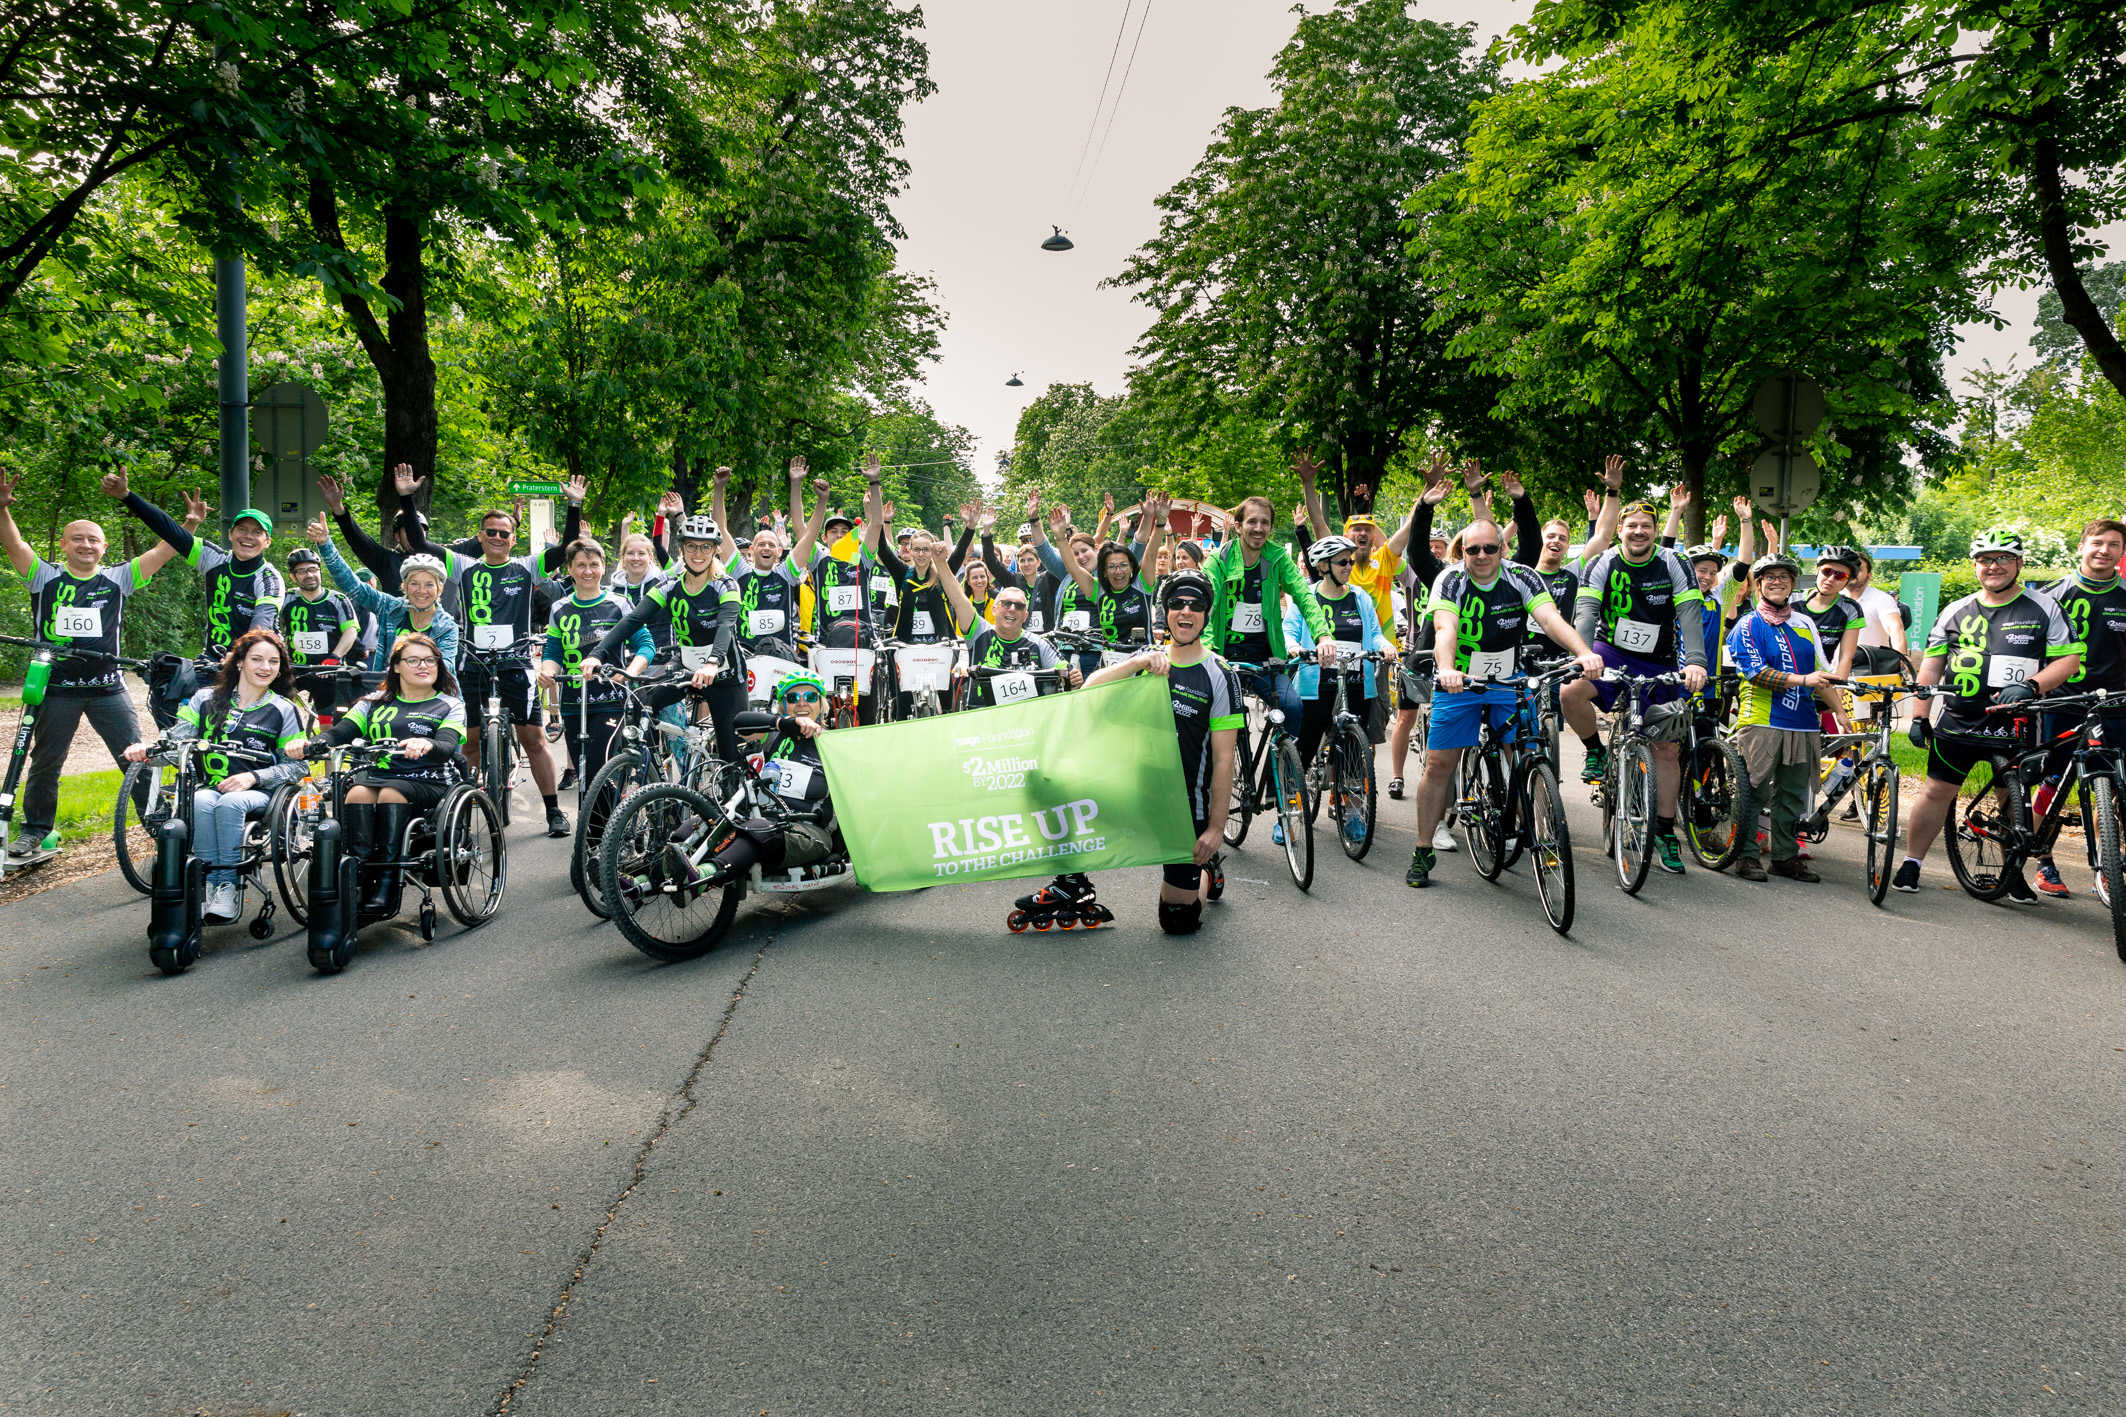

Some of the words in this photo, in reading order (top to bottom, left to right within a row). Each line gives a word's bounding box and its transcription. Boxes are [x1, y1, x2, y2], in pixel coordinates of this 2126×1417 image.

[522, 484, 558, 492] Praterstern
[468, 570, 493, 626] sag
[837, 594, 853, 606] 87
[63, 617, 94, 631] 160
[759, 618, 774, 630] 85
[1245, 613, 1261, 626] 78
[298, 639, 322, 650] 158
[1622, 629, 1652, 647] 137
[1483, 662, 1502, 674] 75
[2003, 667, 2025, 683] 30
[1000, 680, 1027, 698] 164
[986, 773, 1026, 791] 2022
[928, 813, 1032, 859] RISE
[1031, 798, 1099, 841] UP
[933, 862, 959, 877] TO
[960, 854, 998, 873] THE
[999, 837, 1106, 867] CHALLENGE
